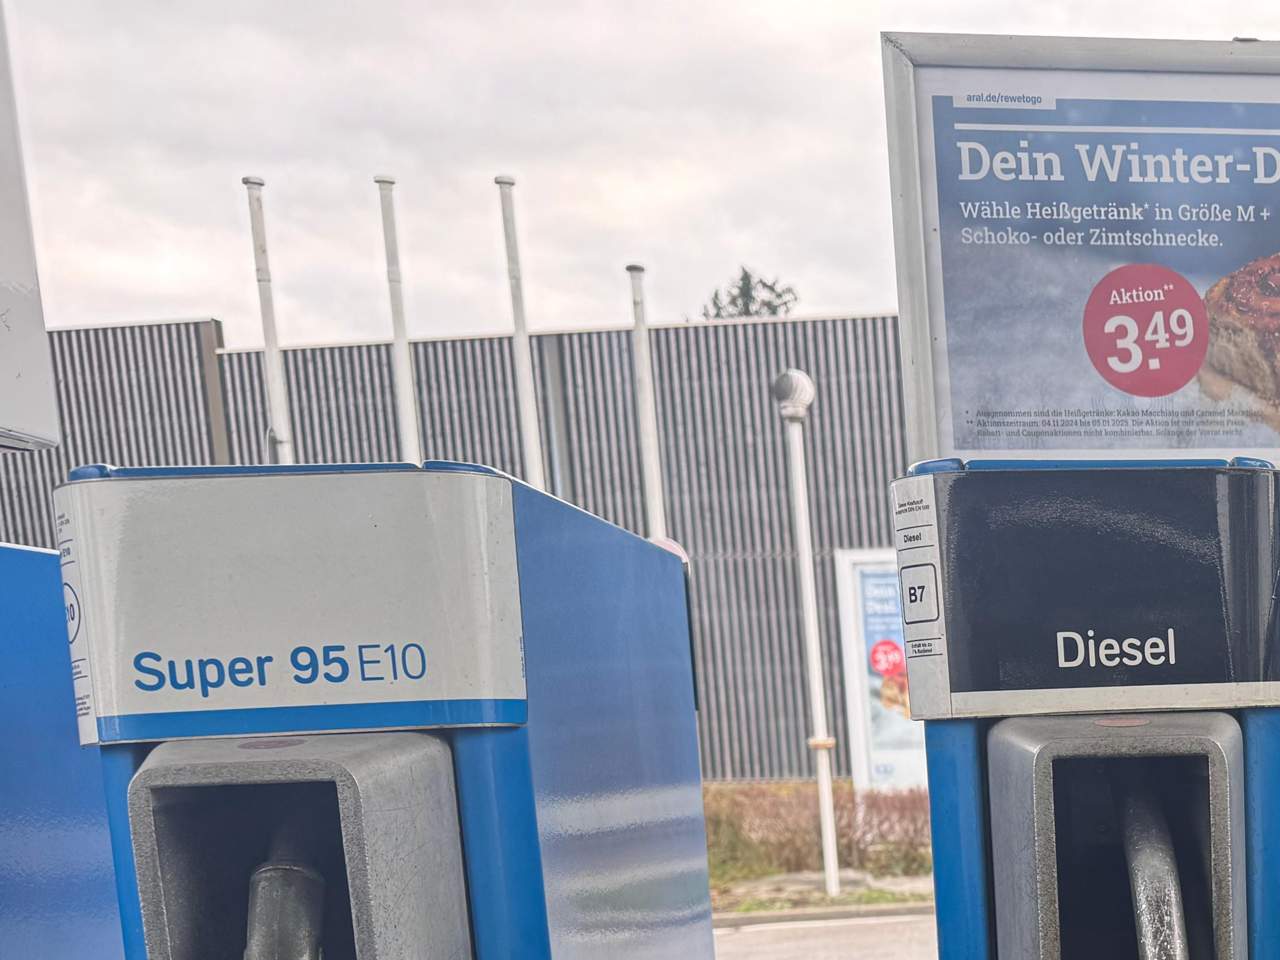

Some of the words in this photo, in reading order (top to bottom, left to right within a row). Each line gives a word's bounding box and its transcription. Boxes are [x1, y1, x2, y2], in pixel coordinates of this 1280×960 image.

[966, 92, 1042, 105] aral.de/rewetogo
[956, 140, 1065, 182] Dein
[959, 201, 1021, 221] Wähle
[1155, 203, 1174, 221] in
[1178, 203, 1232, 223] Größe
[1236, 206, 1256, 222] M
[1259, 209, 1271, 221] +
[961, 227, 1038, 246] Schoko-
[1043, 228, 1085, 246] oder
[1089, 228, 1223, 248] Zimtschnecke.
[903, 532, 922, 543] Diesel
[908, 585, 926, 604] B7
[1056, 628, 1176, 669] Diesel
[133, 651, 274, 698] Super
[290, 645, 350, 685] 95
[358, 642, 427, 683] E10
